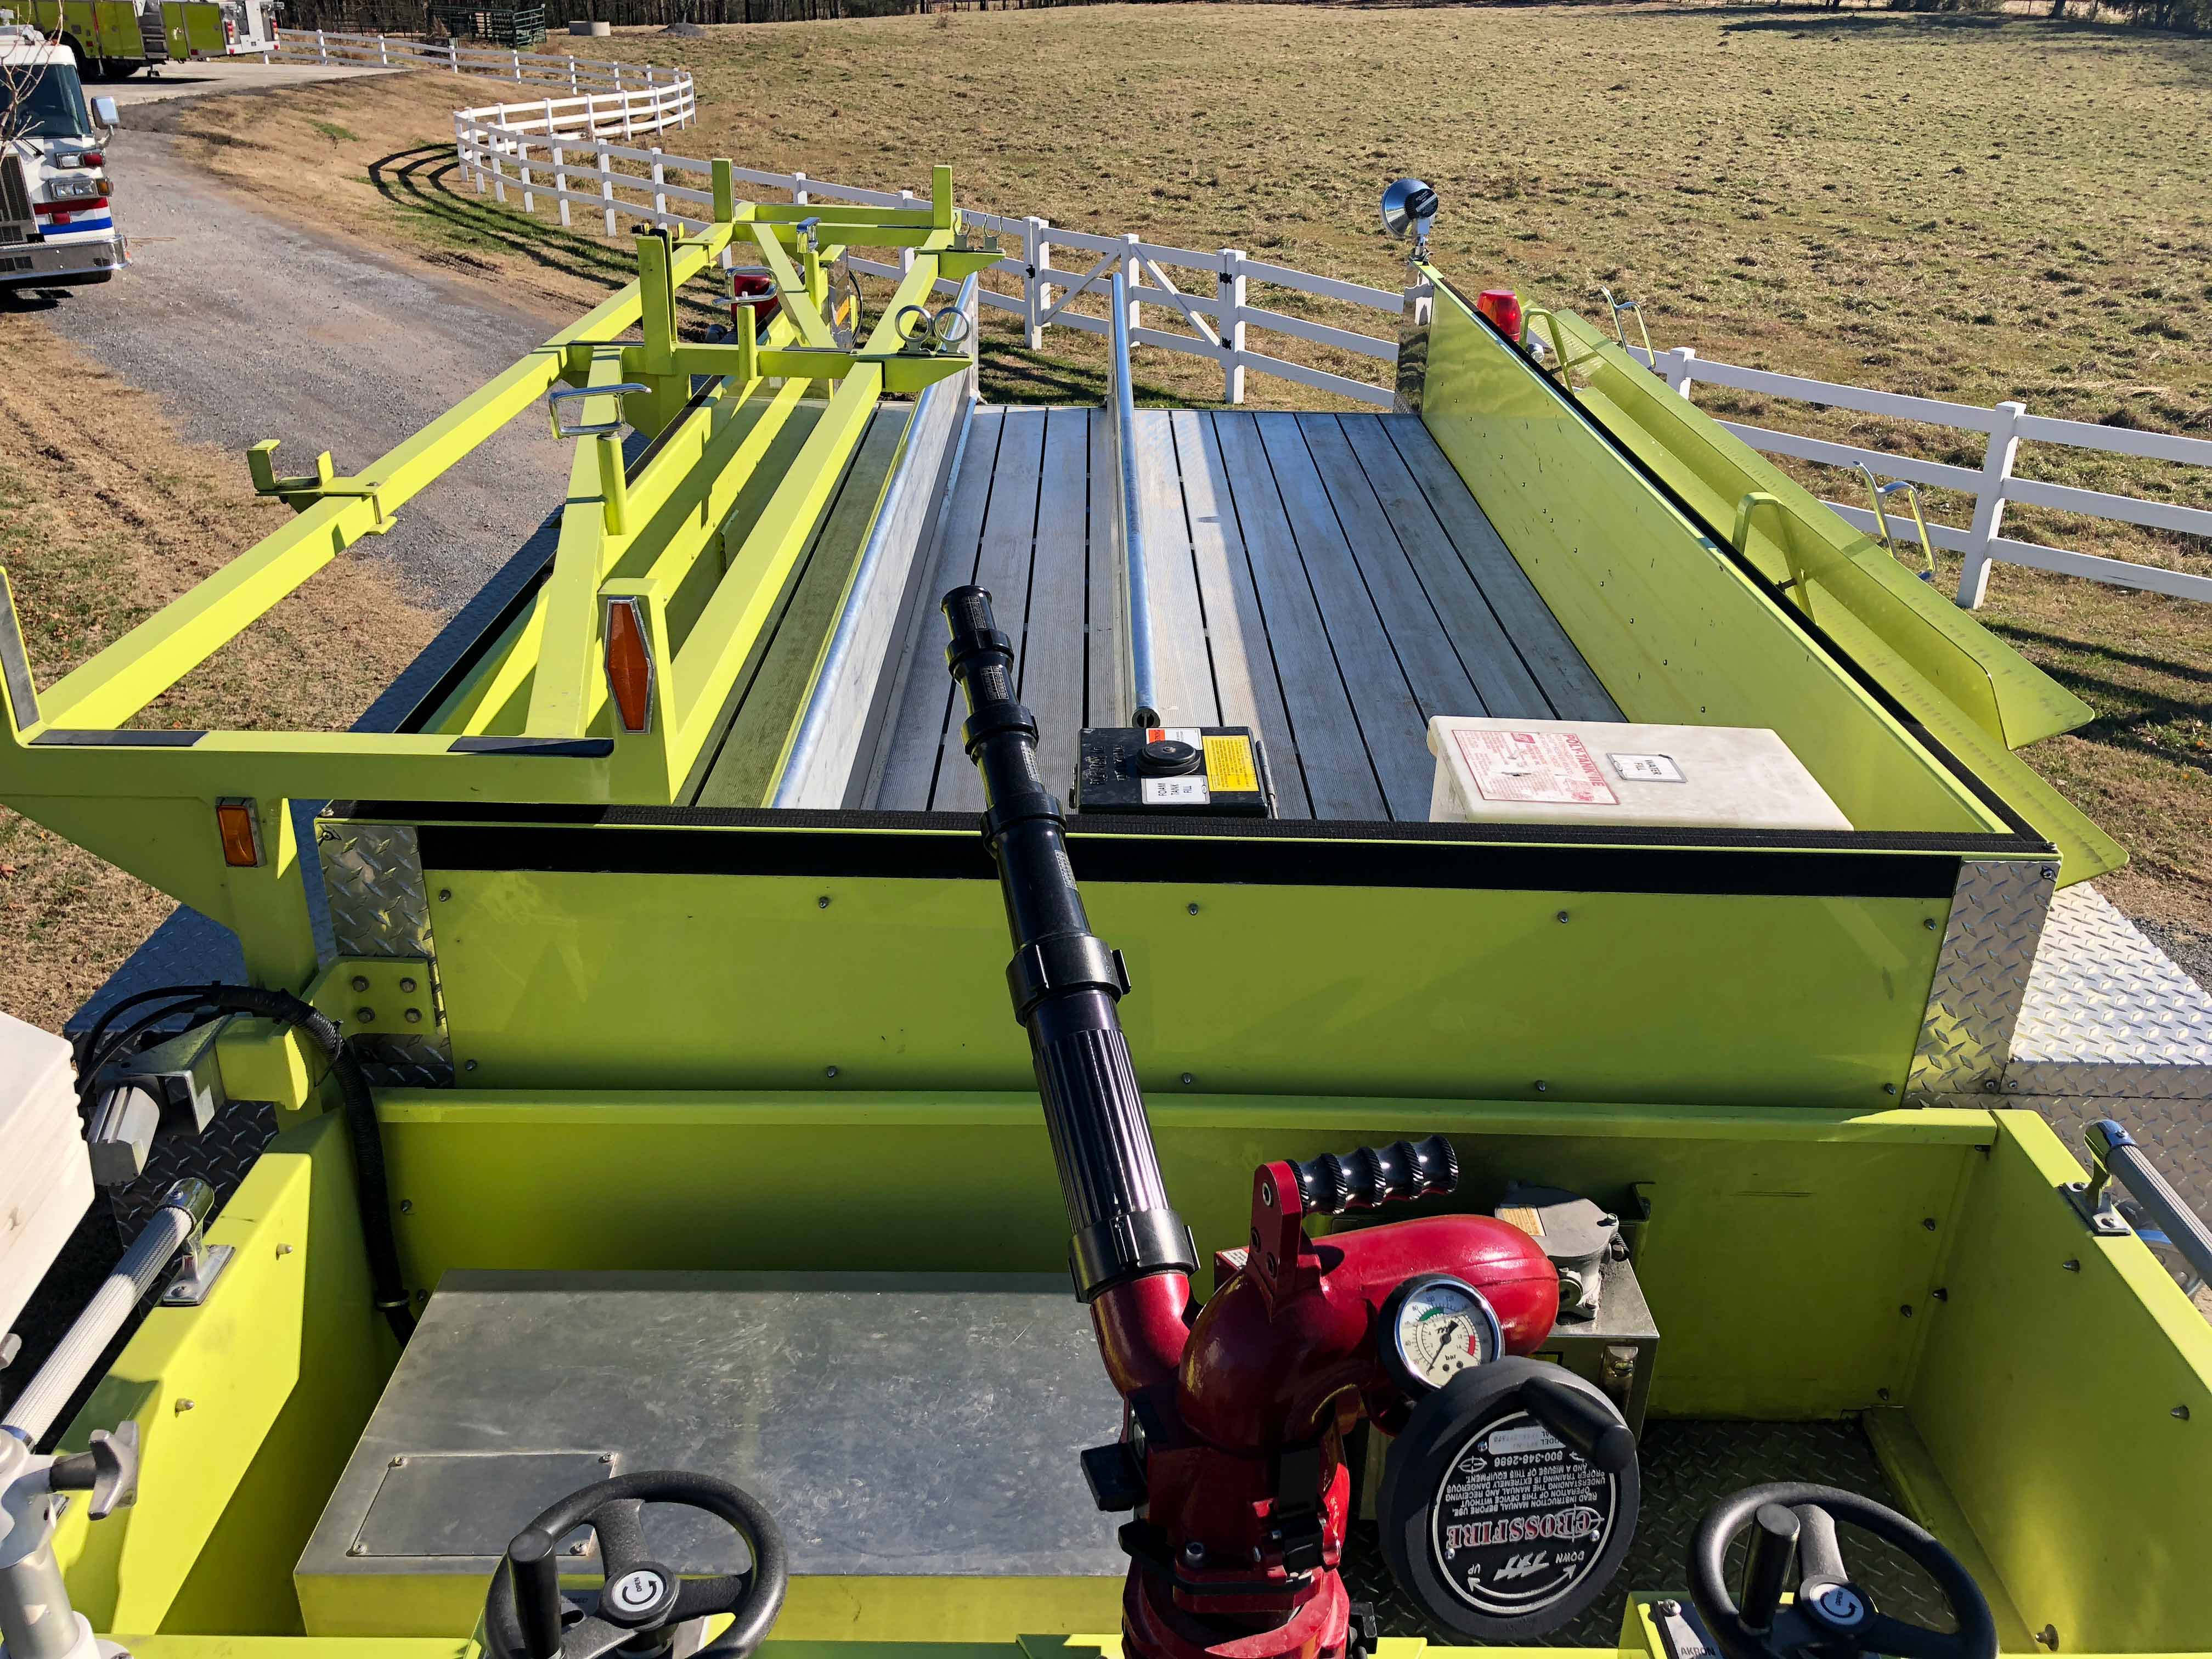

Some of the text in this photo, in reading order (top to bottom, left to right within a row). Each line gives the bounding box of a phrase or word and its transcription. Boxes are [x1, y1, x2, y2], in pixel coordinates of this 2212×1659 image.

[1634, 763, 1646, 771] FILL
[1645, 759, 1662, 775] WATER
[1158, 783, 1167, 796] FOAM
[1171, 784, 1179, 795] TANK
[1527, 1468, 1537, 1477] OF
[1539, 1465, 1564, 1476] MISUSE
[1573, 1463, 1587, 1472] AND
[1510, 1469, 1525, 1479] THIS
[1543, 1473, 1575, 1482] TRAINING
[1447, 1481, 1490, 1493] DANGEROUS
[1493, 1477, 1532, 1488] EXTREMELY
[1445, 1477, 1605, 1502] UNDERSTANDING THE MANUAL AND RECEIVING
[1550, 1486, 1590, 1497] OPERATION
[1494, 1494, 1520, 1504] DEVICE
[1522, 1492, 1537, 1500] THIS
[1579, 1492, 1597, 1502] READ
[1460, 1497, 1492, 1508] WITHOUT
[1500, 1501, 1528, 1511] MANUAL
[1531, 1496, 1577, 1508] INSTRUCTION
[1470, 1504, 1498, 1514] BEFORE
[1446, 1510, 1591, 1549] CROSSFIRE
[1555, 1550, 1584, 1564] DOWN
[1467, 1564, 1481, 1575] UP
[634, 1576, 642, 1592] OPEN
[1681, 1647, 1716, 1656] AKRON
